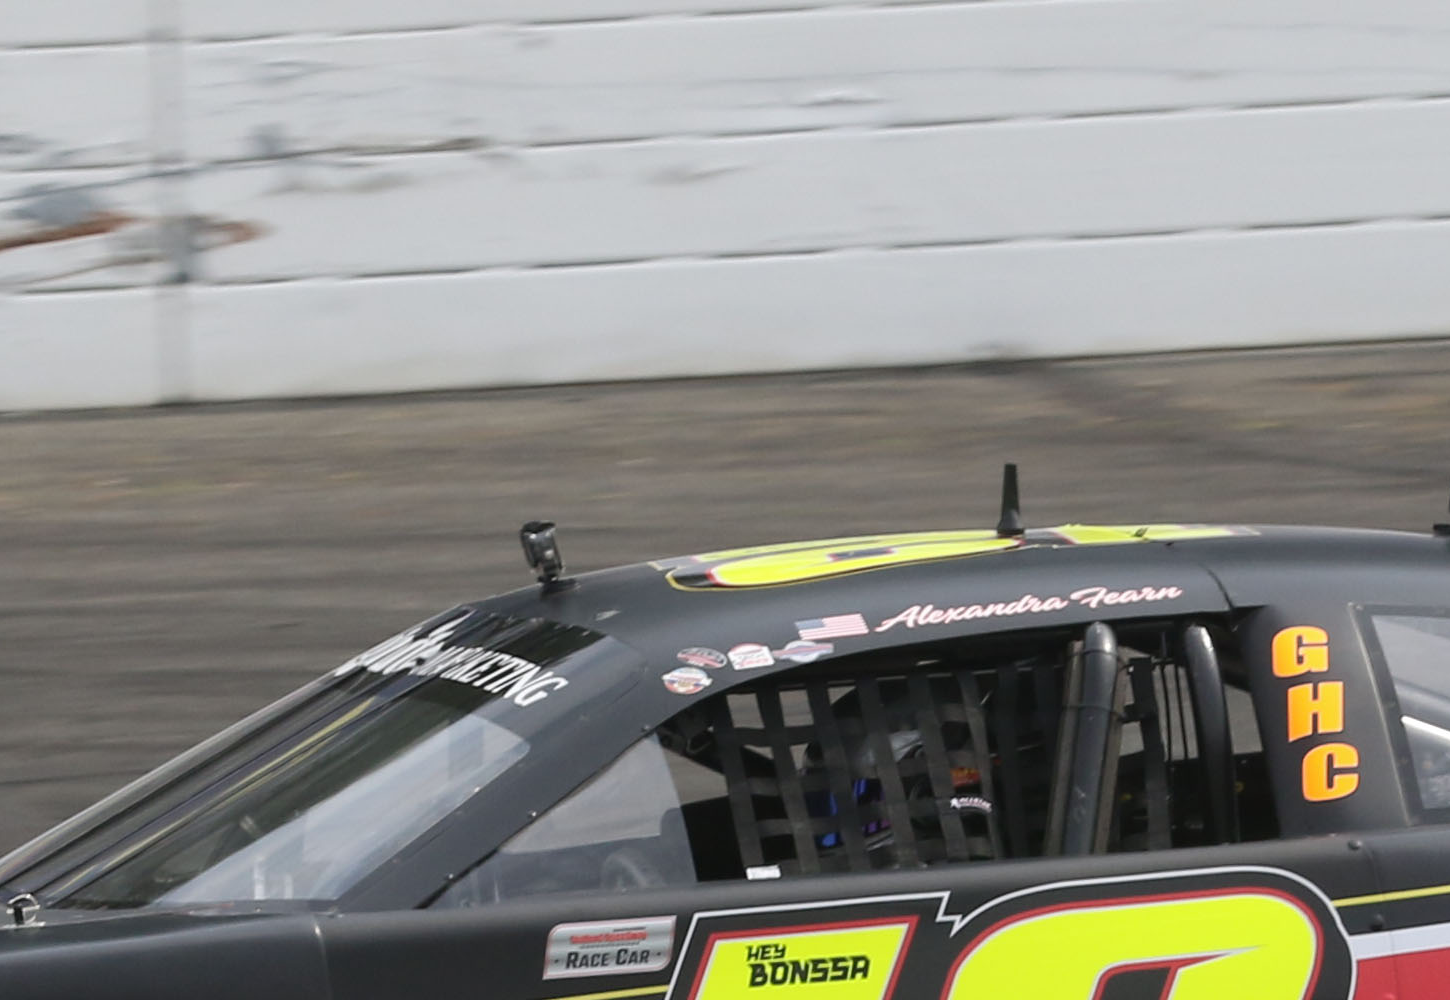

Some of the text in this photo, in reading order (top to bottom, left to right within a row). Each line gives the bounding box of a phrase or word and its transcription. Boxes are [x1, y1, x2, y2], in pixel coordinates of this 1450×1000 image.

[873, 583, 1184, 633] Alexandra Fearn
[565, 948, 651, 970] RACE CAR
[746, 943, 787, 962] HEY
